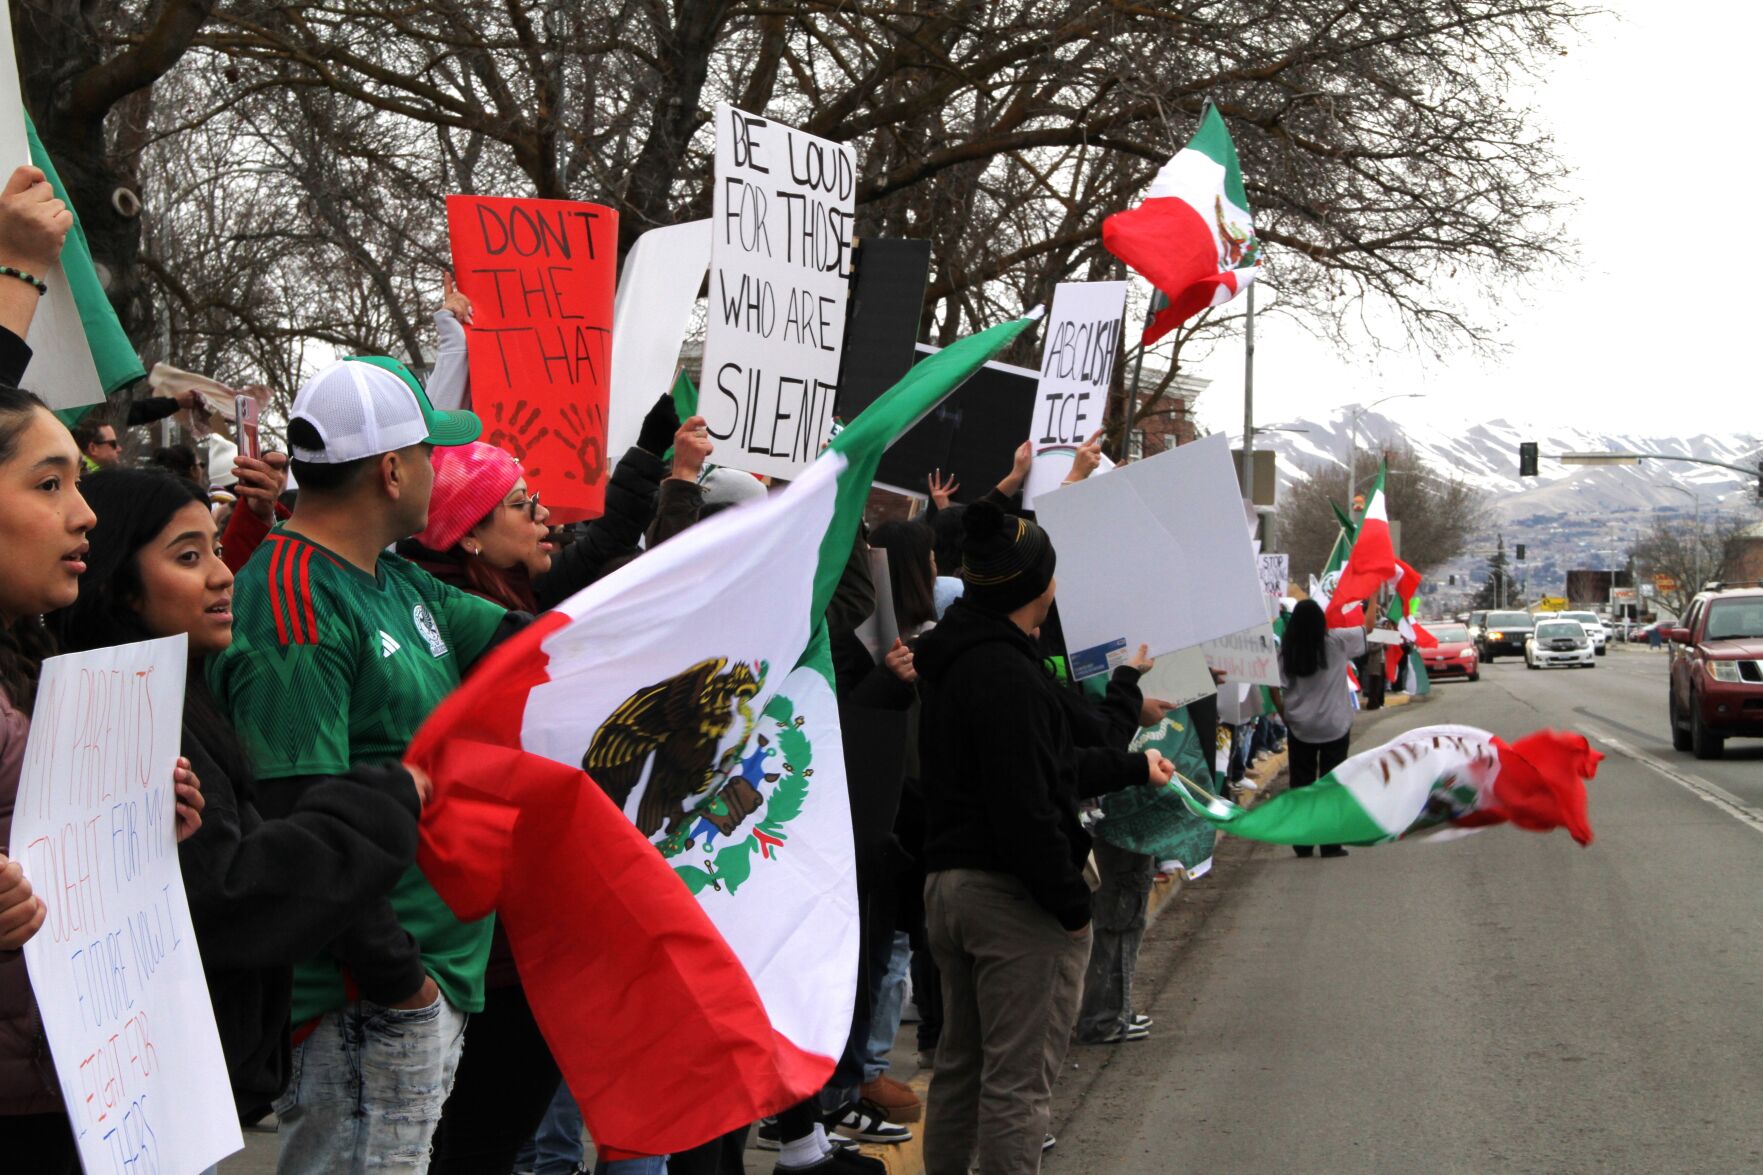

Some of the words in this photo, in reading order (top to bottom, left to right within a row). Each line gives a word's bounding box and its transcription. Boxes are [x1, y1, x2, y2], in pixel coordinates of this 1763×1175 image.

[731, 110, 770, 174] BE
[788, 132, 853, 202] LOUD
[476, 203, 599, 260] DON'T
[725, 177, 772, 258] FOR
[776, 190, 855, 279] THOSE
[471, 266, 585, 319] THE
[719, 268, 776, 339] WHO
[784, 287, 836, 352] ARE
[470, 326, 611, 388] THAT
[1043, 318, 1120, 387] ABOLISH
[706, 362, 837, 463] SILENT
[1039, 392, 1090, 444] ICE
[1263, 555, 1284, 570] STOP
[69, 665, 155, 809] PARENTS
[111, 801, 142, 895] FOR
[145, 783, 167, 865] MY
[127, 903, 165, 992] NOW
[163, 883, 181, 950] I
[123, 1010, 160, 1081] FOR
